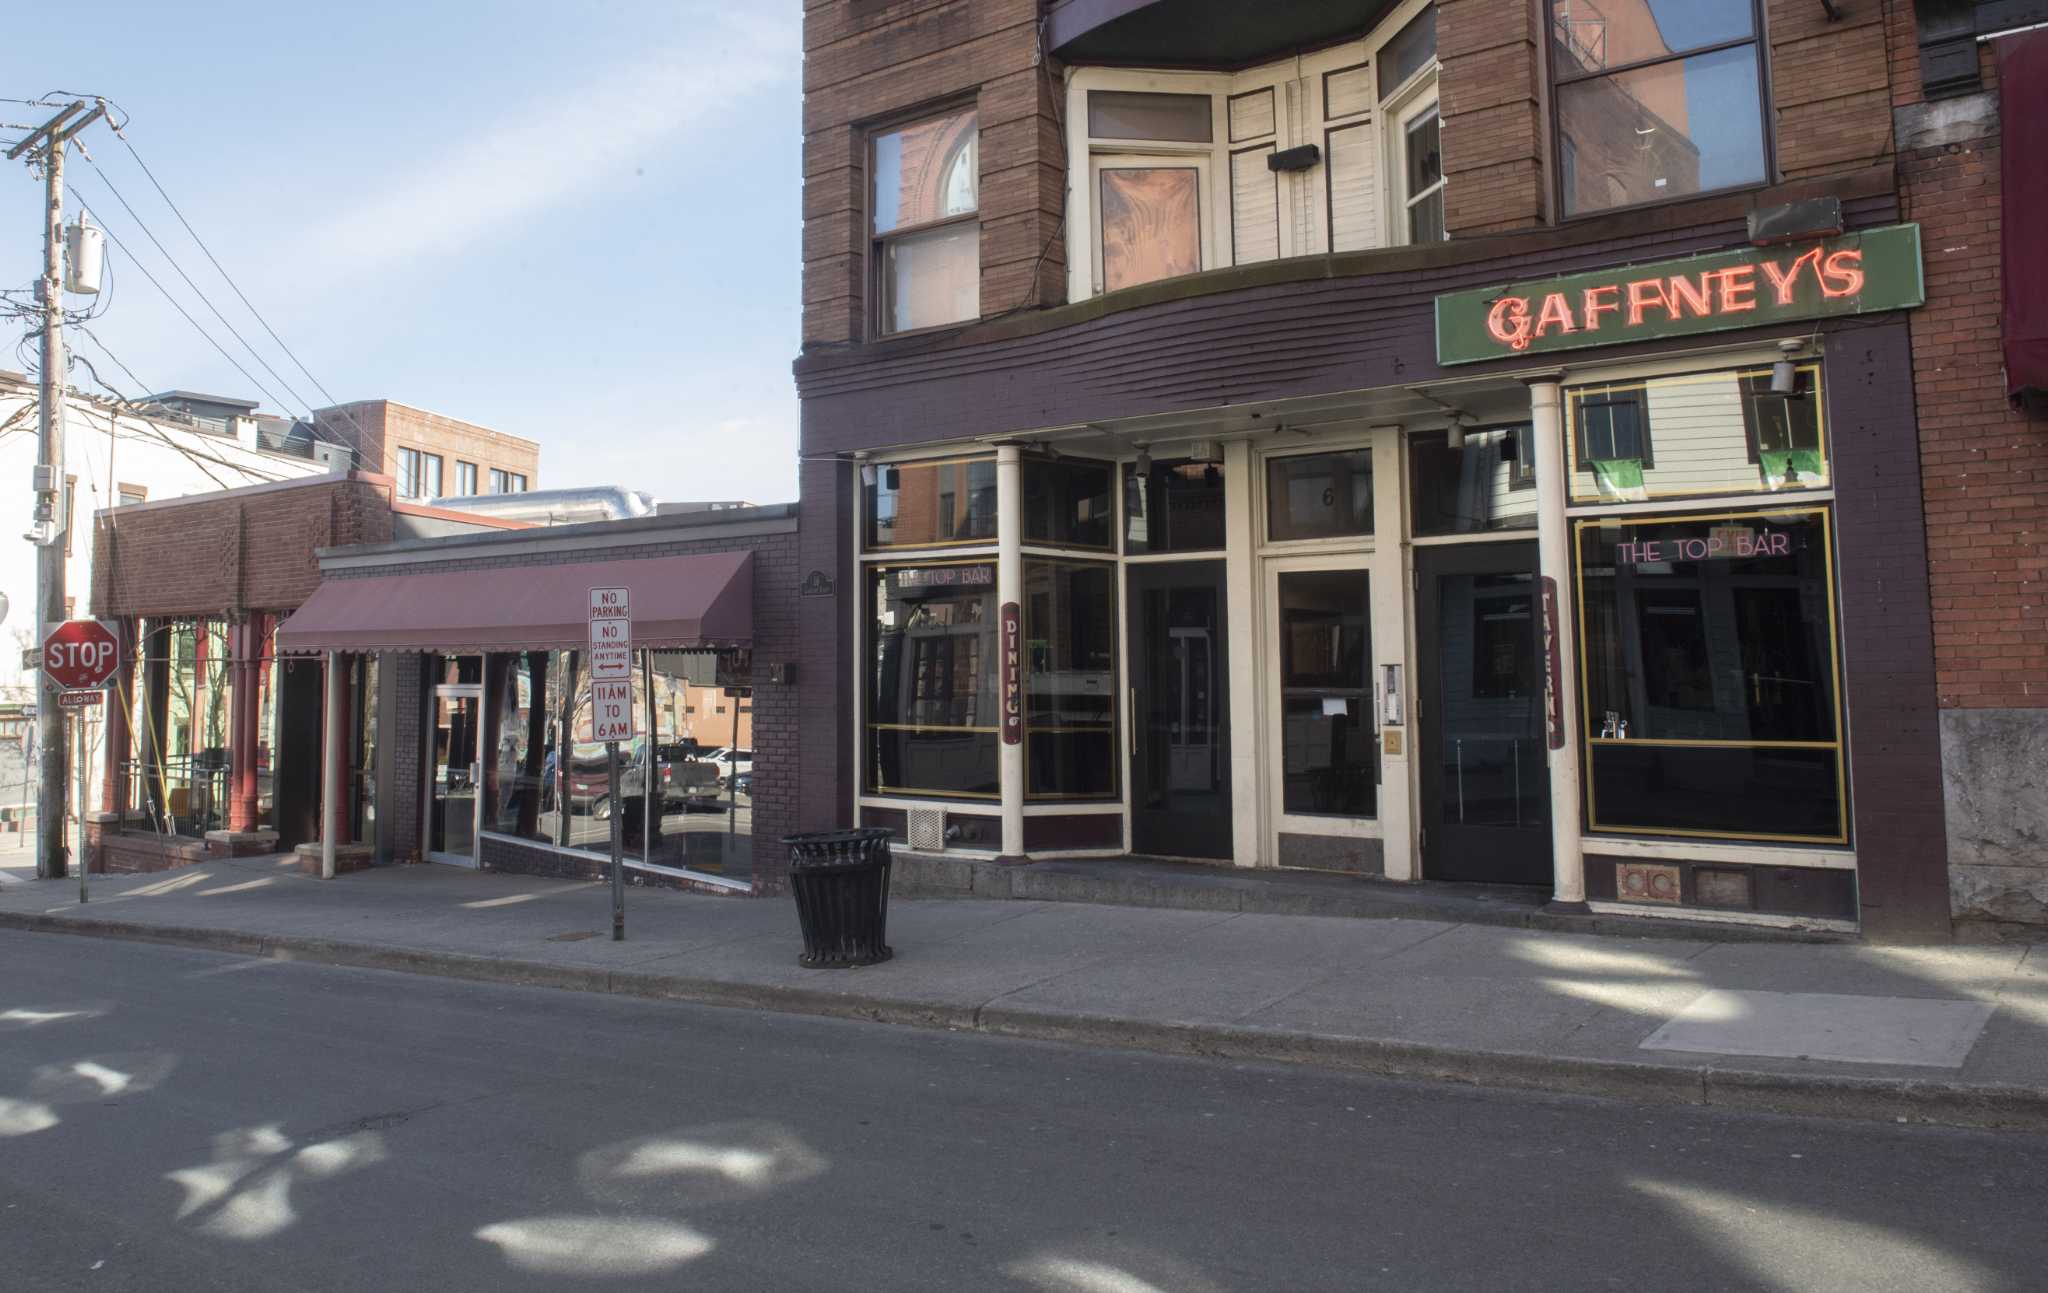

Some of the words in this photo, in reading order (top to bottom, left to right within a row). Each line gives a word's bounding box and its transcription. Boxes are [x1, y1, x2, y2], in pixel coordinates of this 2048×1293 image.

[1486, 245, 1865, 351] GAFFNEY'S
[1321, 487, 1334, 506] 6
[1617, 541, 1662, 563] THE
[1673, 536, 1722, 561] TOP
[1736, 533, 1790, 558] BAR
[930, 571, 955, 585] TOP
[962, 567, 992, 585] BAR
[601, 592, 617, 604] NO
[592, 605, 628, 618] PARKING
[602, 626, 617, 638] NO
[592, 641, 628, 650] STANDING
[49, 642, 113, 668] STOP
[593, 651, 627, 660] ANYTIME
[1006, 620, 1018, 714] DINING
[604, 704, 620, 718] TO
[608, 722, 627, 736] AM
